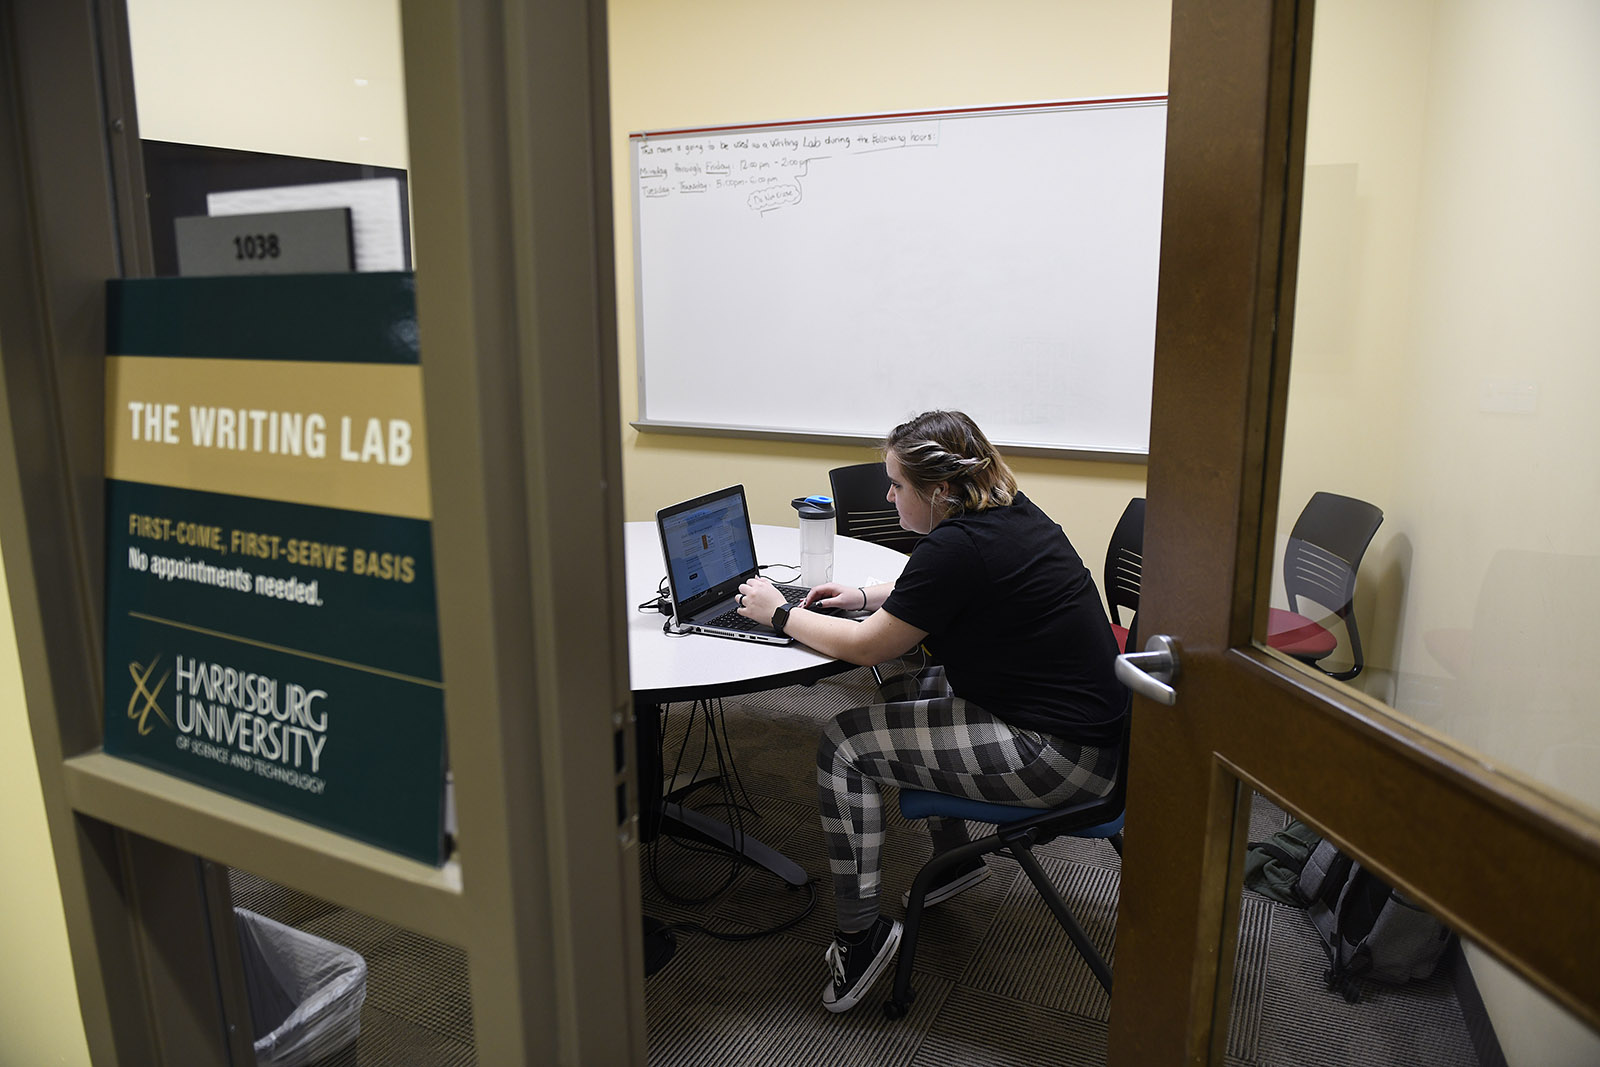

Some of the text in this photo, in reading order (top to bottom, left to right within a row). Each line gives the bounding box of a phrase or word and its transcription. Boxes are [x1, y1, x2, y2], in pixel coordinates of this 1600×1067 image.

[640, 144, 654, 155] This
[656, 145, 673, 154] room
[685, 143, 704, 155] going
[707, 140, 716, 151] to
[720, 141, 729, 150] be
[733, 139, 750, 149] used
[769, 137, 799, 151] Writing
[803, 136, 821, 149] Lab
[824, 135, 851, 149] during
[857, 136, 869, 144] the
[872, 133, 906, 146] following
[640, 165, 668, 178] Monday
[674, 163, 702, 176] through
[641, 185, 670, 198] Tuesday
[233, 234, 281, 260] 1038
[128, 402, 412, 466] THE WRITING LAB
[128, 547, 324, 607] No appointments needed.
[129, 514, 416, 583] FIRST-COME, FIRST-SERVE BASIS
[176, 655, 329, 732] HARRISBURG
[176, 694, 327, 772] UNIVERSITY
[176, 735, 326, 794] OF SCIENCE AND TECHNOLOGY
